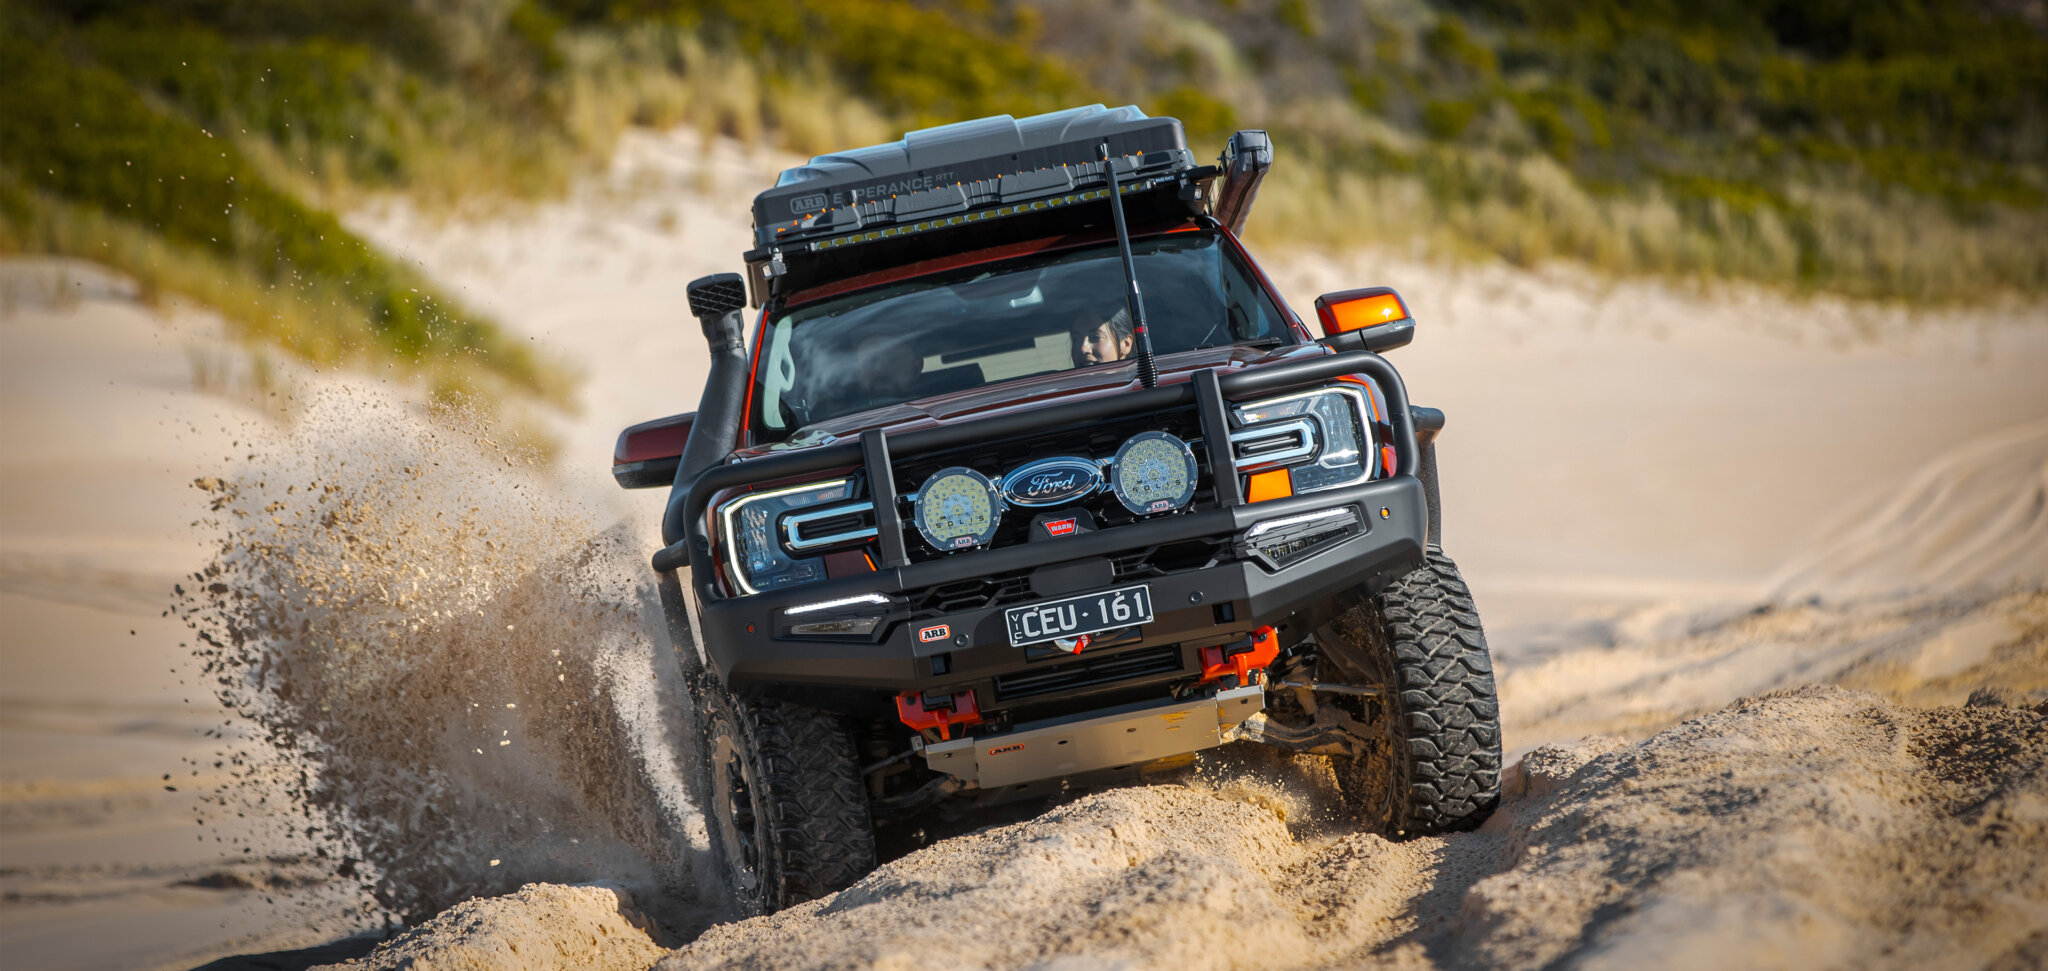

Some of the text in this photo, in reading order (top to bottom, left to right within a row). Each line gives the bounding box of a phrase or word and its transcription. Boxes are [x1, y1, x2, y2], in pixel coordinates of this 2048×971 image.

[795, 196, 826, 211] ARB
[833, 176, 933, 204] EPERANCE
[935, 172, 954, 181] RTT
[1028, 471, 1075, 496] Ford
[935, 515, 984, 529] SOLIS
[1051, 523, 1072, 532] WARN
[1011, 614, 1023, 640] VIC
[1022, 592, 1144, 637] CEU 161
[924, 628, 947, 639] ARB
